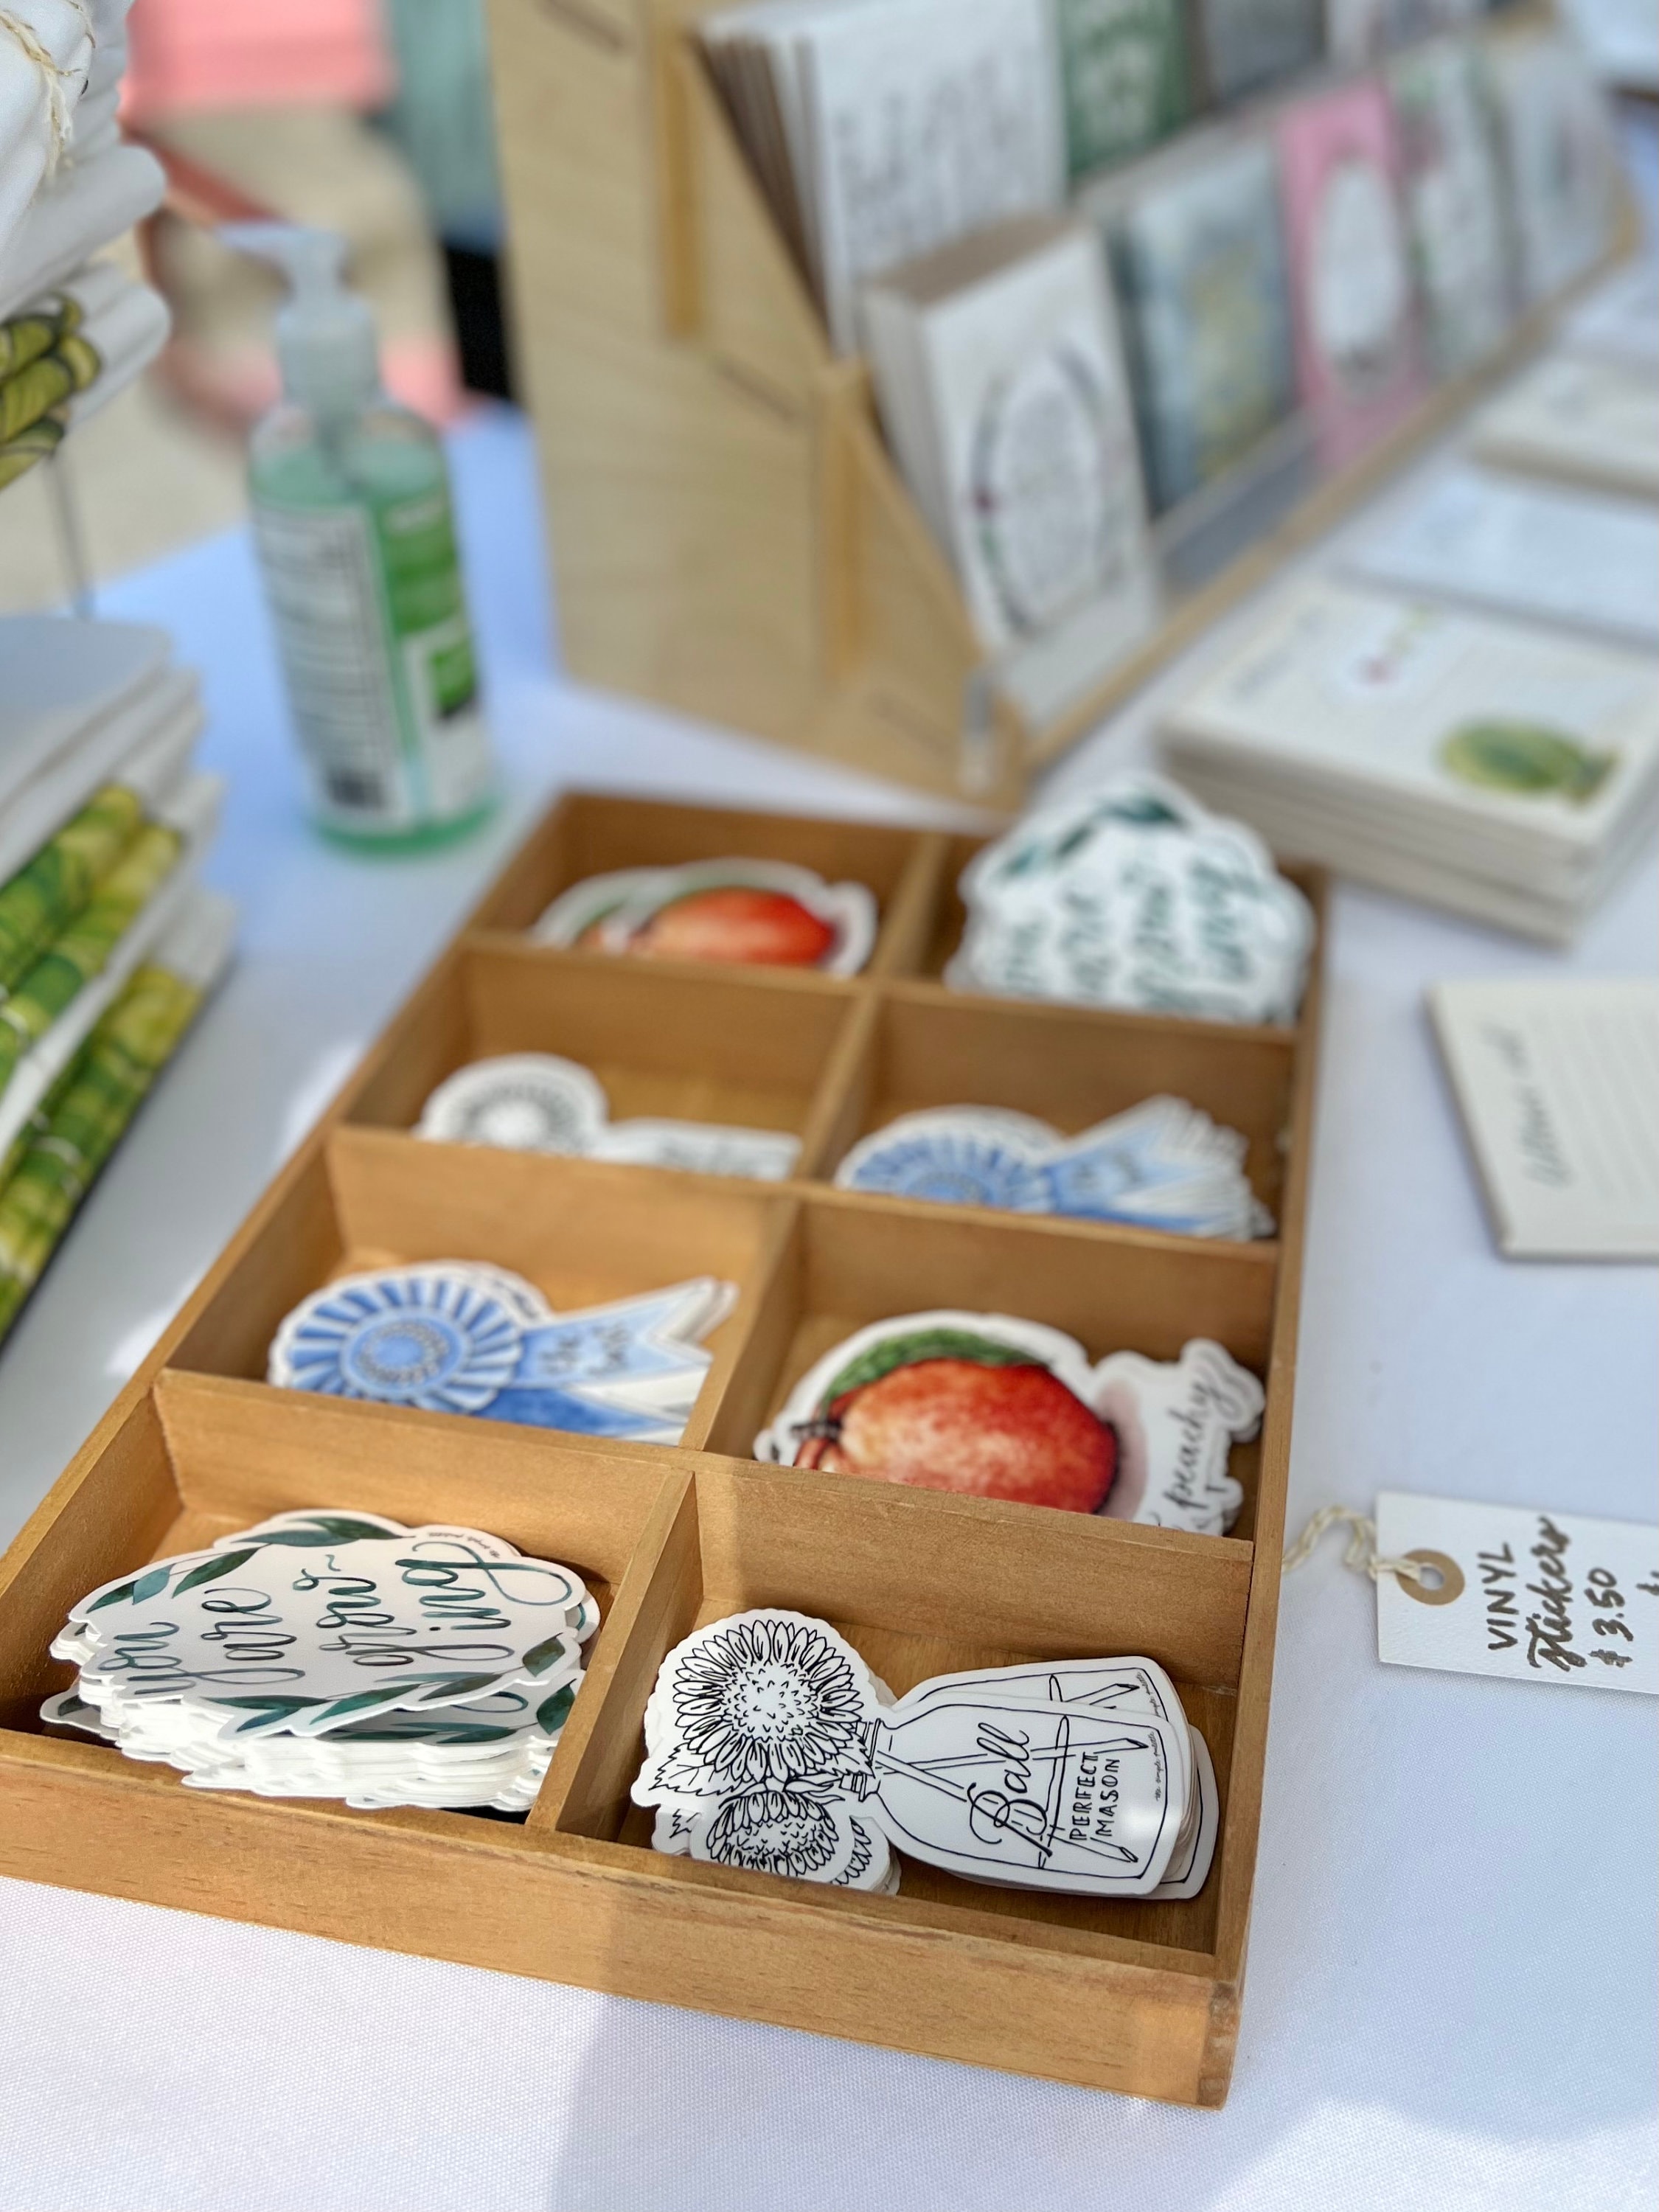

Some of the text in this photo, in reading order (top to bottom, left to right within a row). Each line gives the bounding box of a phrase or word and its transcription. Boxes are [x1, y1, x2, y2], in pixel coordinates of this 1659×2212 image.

[1162, 1377, 1242, 1509] peachy
[201, 1588, 297, 1660] are
[394, 1541, 572, 1630] ing
[1478, 1543, 1519, 1650] VINYL
[100, 1621, 305, 1694] you
[967, 1722, 1053, 1857] Ball
[1070, 1752, 1099, 1841] PERFECT
[1095, 1759, 1120, 1837] MASON
